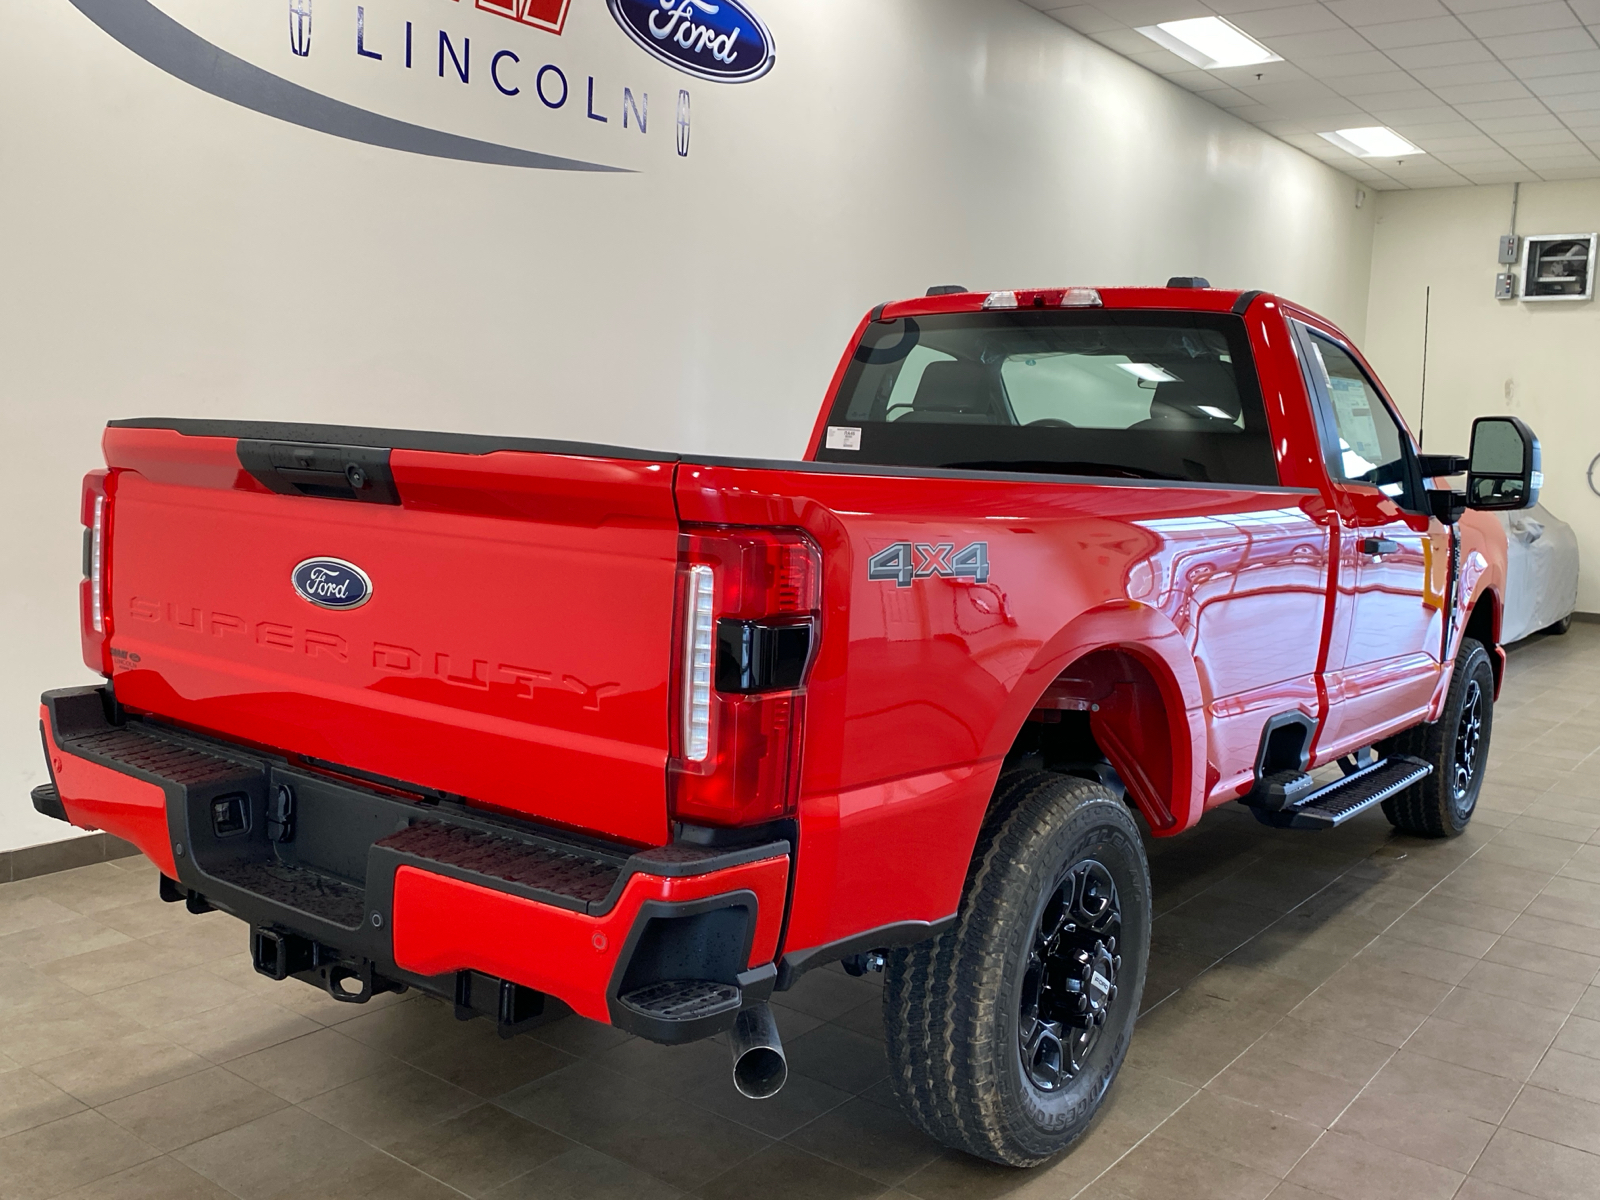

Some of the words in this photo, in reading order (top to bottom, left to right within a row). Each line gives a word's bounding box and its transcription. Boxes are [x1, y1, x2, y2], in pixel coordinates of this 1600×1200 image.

[356, 5, 649, 135] LINCOLN
[648, 0, 741, 65] Ford
[305, 566, 350, 599] Ford
[129, 596, 349, 664] SUPER
[371, 640, 622, 712] DUTY
